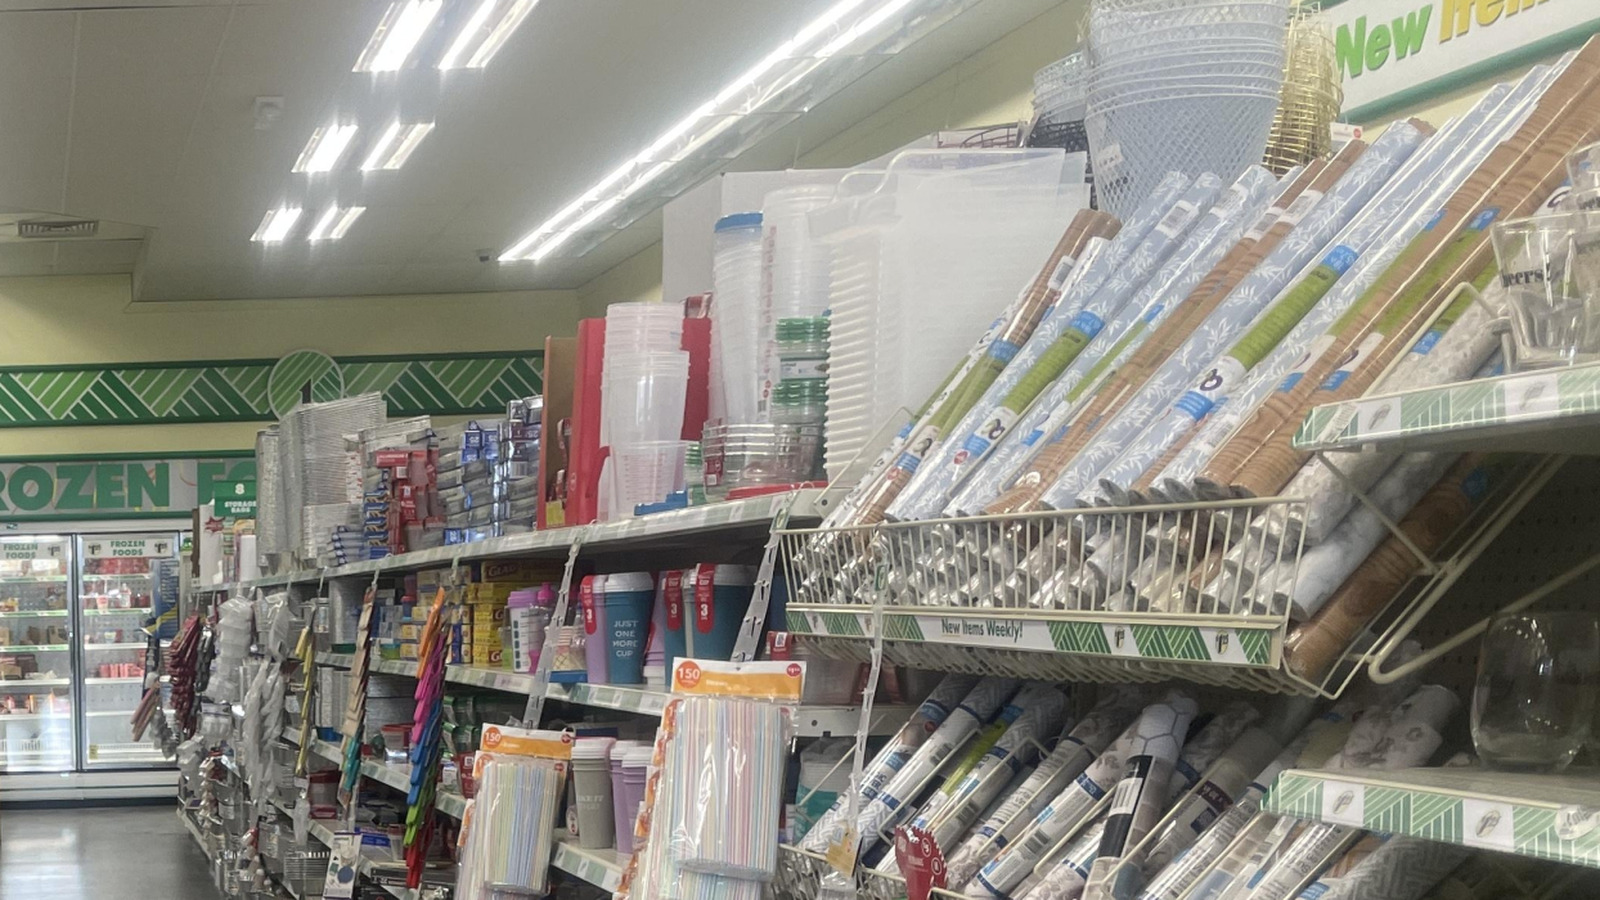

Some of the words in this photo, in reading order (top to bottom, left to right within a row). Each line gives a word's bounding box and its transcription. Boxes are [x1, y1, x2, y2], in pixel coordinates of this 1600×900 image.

[1336, 4, 1433, 83] New
[235, 483, 245, 495] 8
[3, 543, 39, 551] FROZEN
[110, 540, 146, 548] FROZEN
[671, 602, 678, 614] 3
[700, 603, 708, 616] 3
[586, 608, 593, 620] 3
[613, 620, 639, 628] JUST
[615, 630, 636, 638] ONE
[941, 618, 961, 634] New
[961, 618, 985, 636] Items
[985, 620, 1024, 643] Weekly!
[612, 640, 639, 648] MORE
[615, 650, 634, 658] CUP
[678, 668, 701, 680] 150
[485, 732, 502, 742] 150
